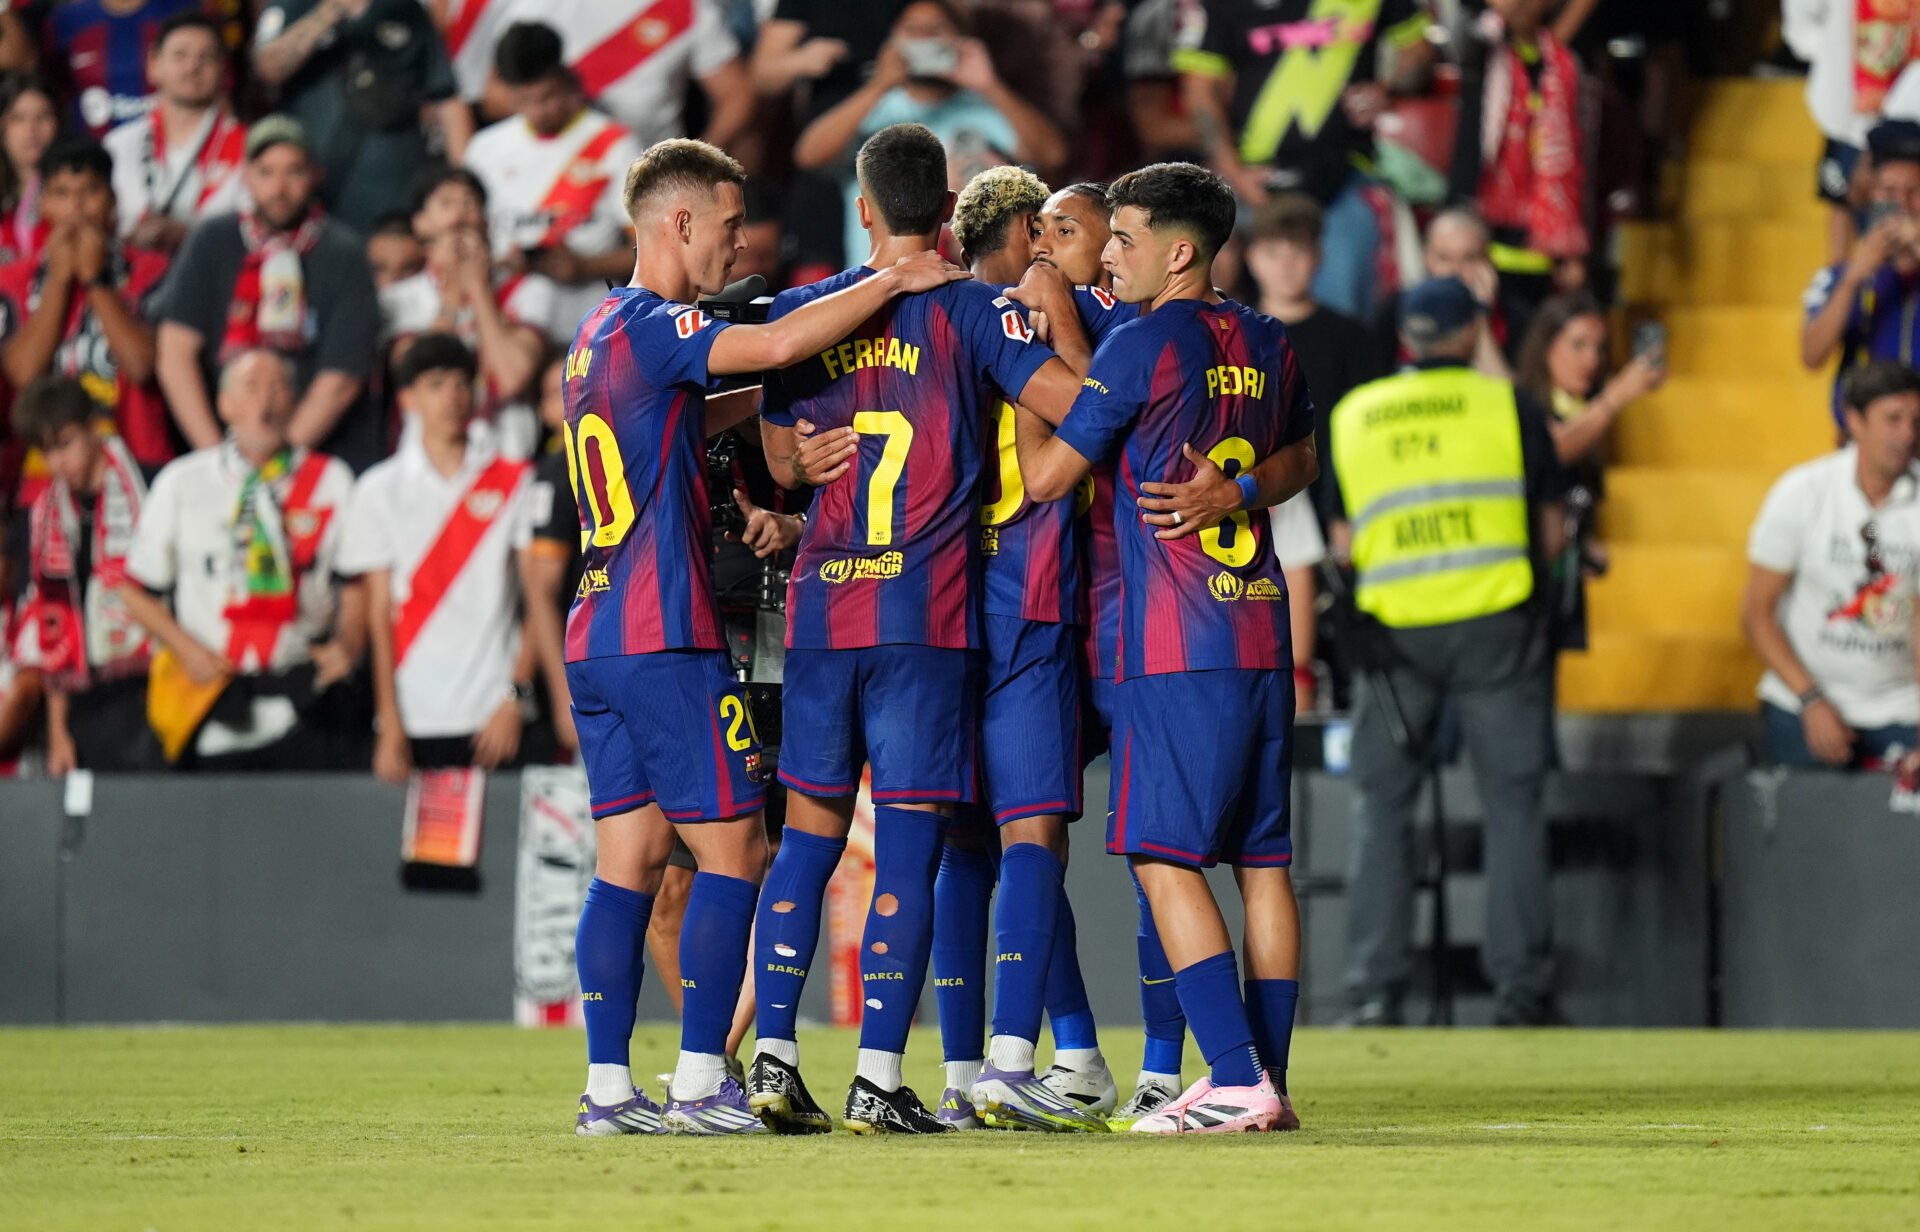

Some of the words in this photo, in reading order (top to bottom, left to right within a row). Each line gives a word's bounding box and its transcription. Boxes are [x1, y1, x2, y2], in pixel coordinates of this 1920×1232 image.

[565, 347, 593, 382] OLMO
[821, 337, 920, 380] FERRAN
[1205, 365, 1266, 400] PEDRI
[853, 410, 914, 545] 7
[1199, 436, 1257, 568] 8
[1246, 583, 1281, 595] ACNUR
[767, 963, 806, 978] BARÇA
[863, 971, 904, 982] BARÇA
